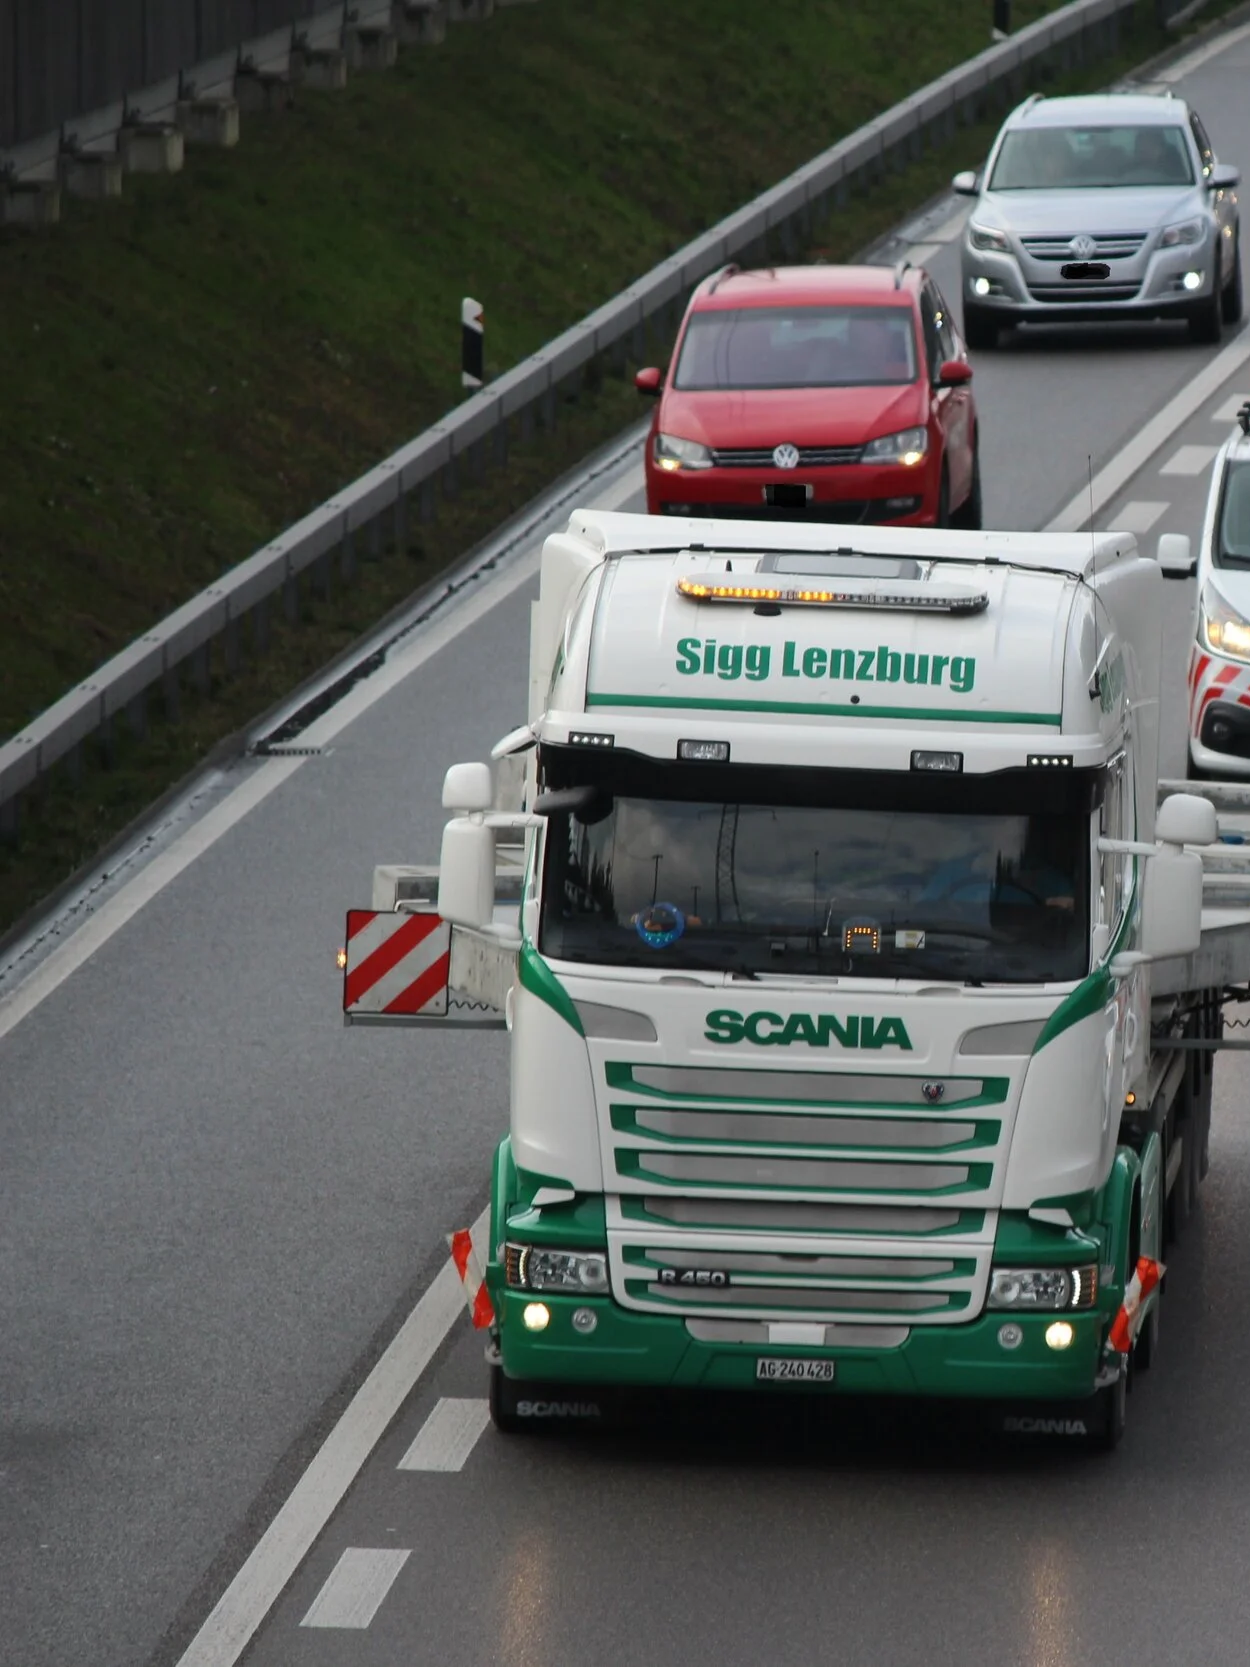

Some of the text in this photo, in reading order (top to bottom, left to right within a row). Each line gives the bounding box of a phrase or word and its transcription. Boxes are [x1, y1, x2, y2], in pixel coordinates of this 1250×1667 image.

[675, 637, 976, 693] Sigg Lenzburg
[703, 1009, 914, 1051] SCANIA
[516, 1400, 601, 1417] SCANIA
[1003, 1417, 1087, 1435] SCANIA
